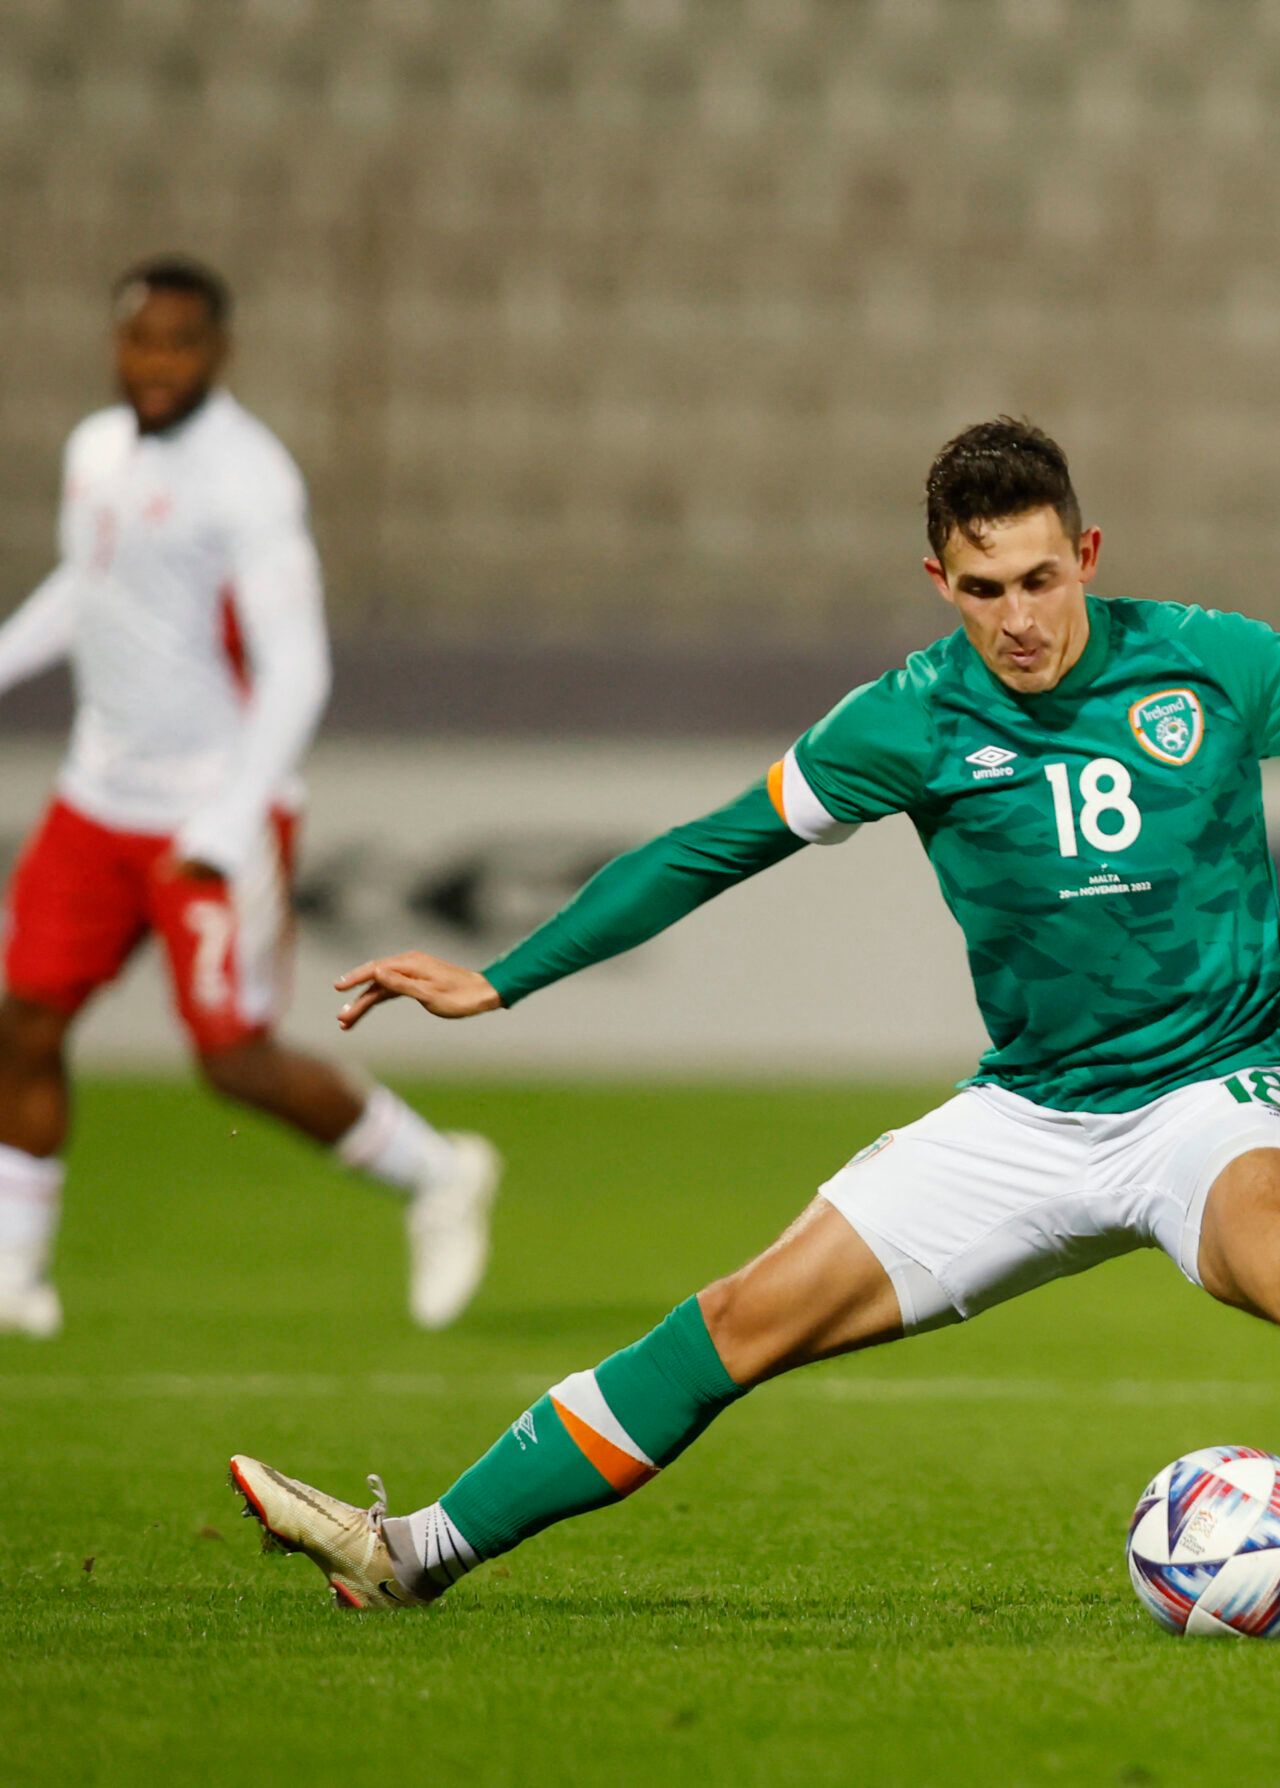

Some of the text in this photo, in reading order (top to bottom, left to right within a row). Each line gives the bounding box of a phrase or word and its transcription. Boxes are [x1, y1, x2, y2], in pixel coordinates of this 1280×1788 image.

[1140, 697, 1185, 722] Ireland
[972, 766, 1014, 779] umbro
[1045, 758, 1142, 857] 18
[1088, 873, 1120, 884] MALTA
[1079, 883, 1130, 896] NOVEMBER
[1130, 880, 1152, 892] 2022
